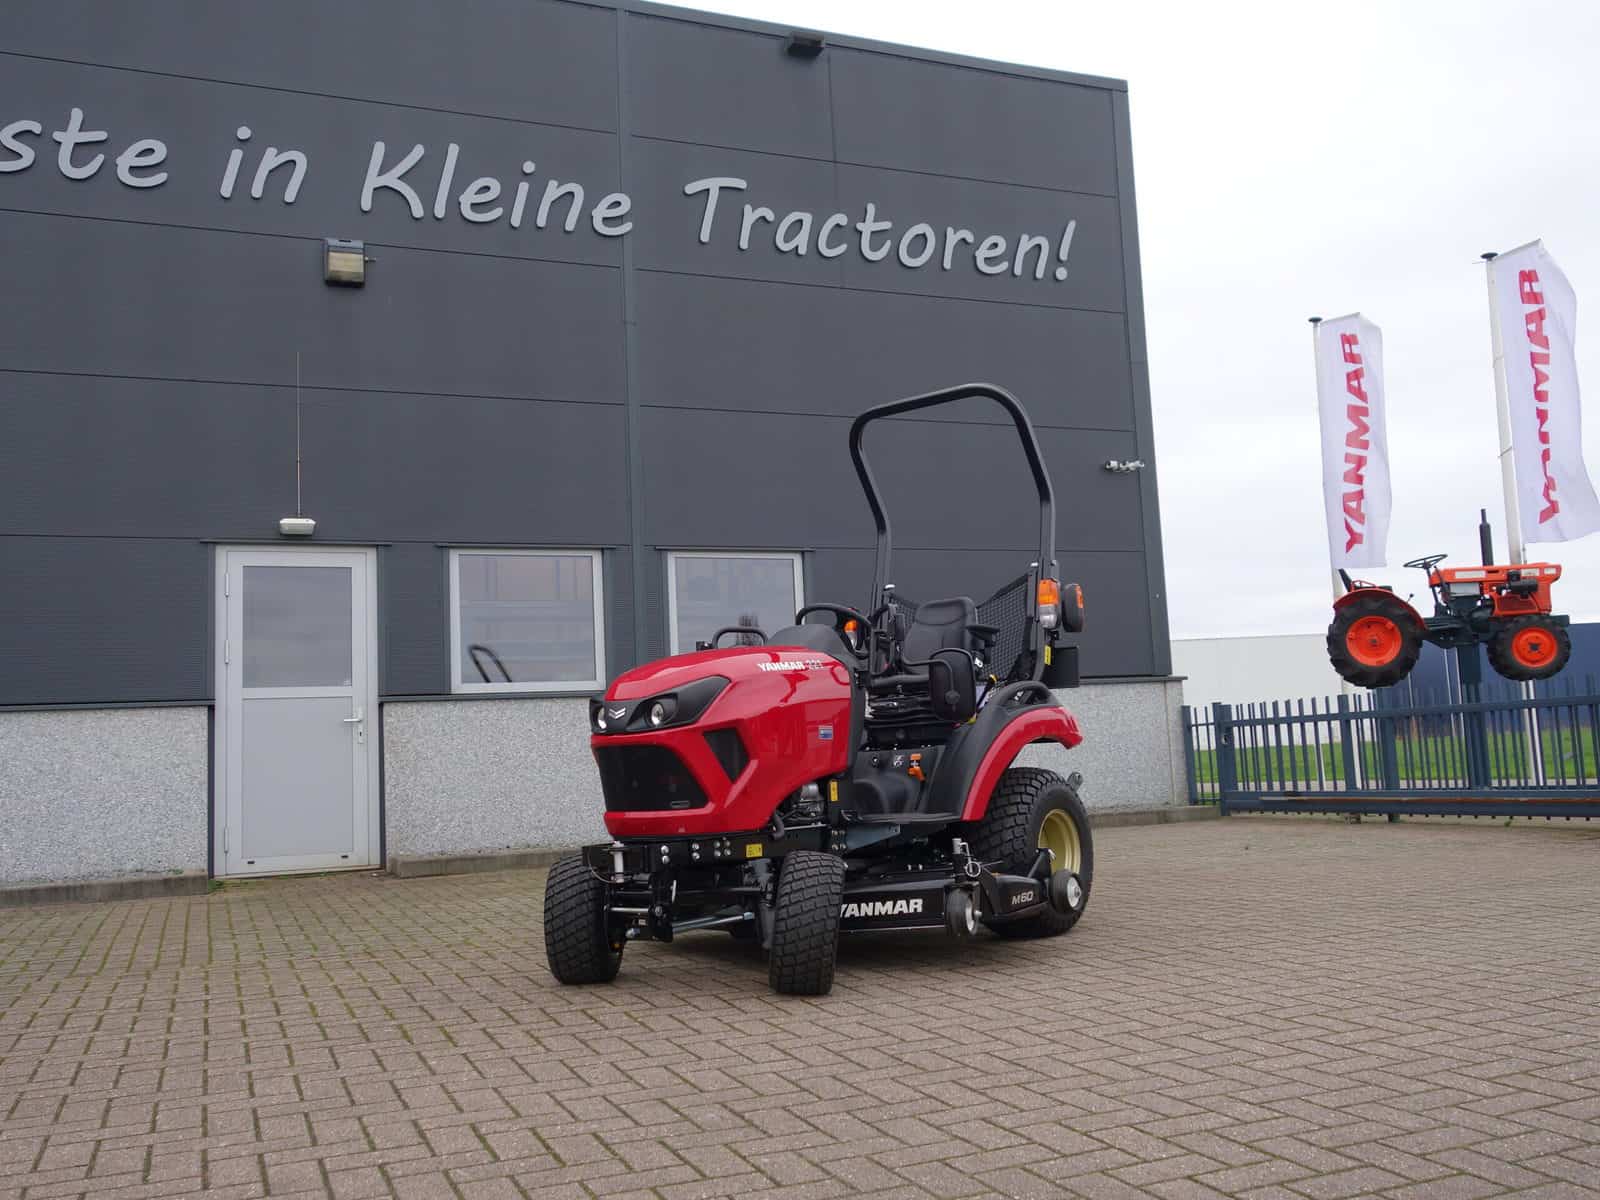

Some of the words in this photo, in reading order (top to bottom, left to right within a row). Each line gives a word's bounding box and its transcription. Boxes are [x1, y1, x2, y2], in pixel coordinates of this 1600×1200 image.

[220, 126, 308, 203] in
[361, 140, 633, 236] Kleine
[684, 176, 1076, 280] Tractoren!
[1340, 333, 1370, 553] YANMAR
[757, 661, 805, 671] YANMAR
